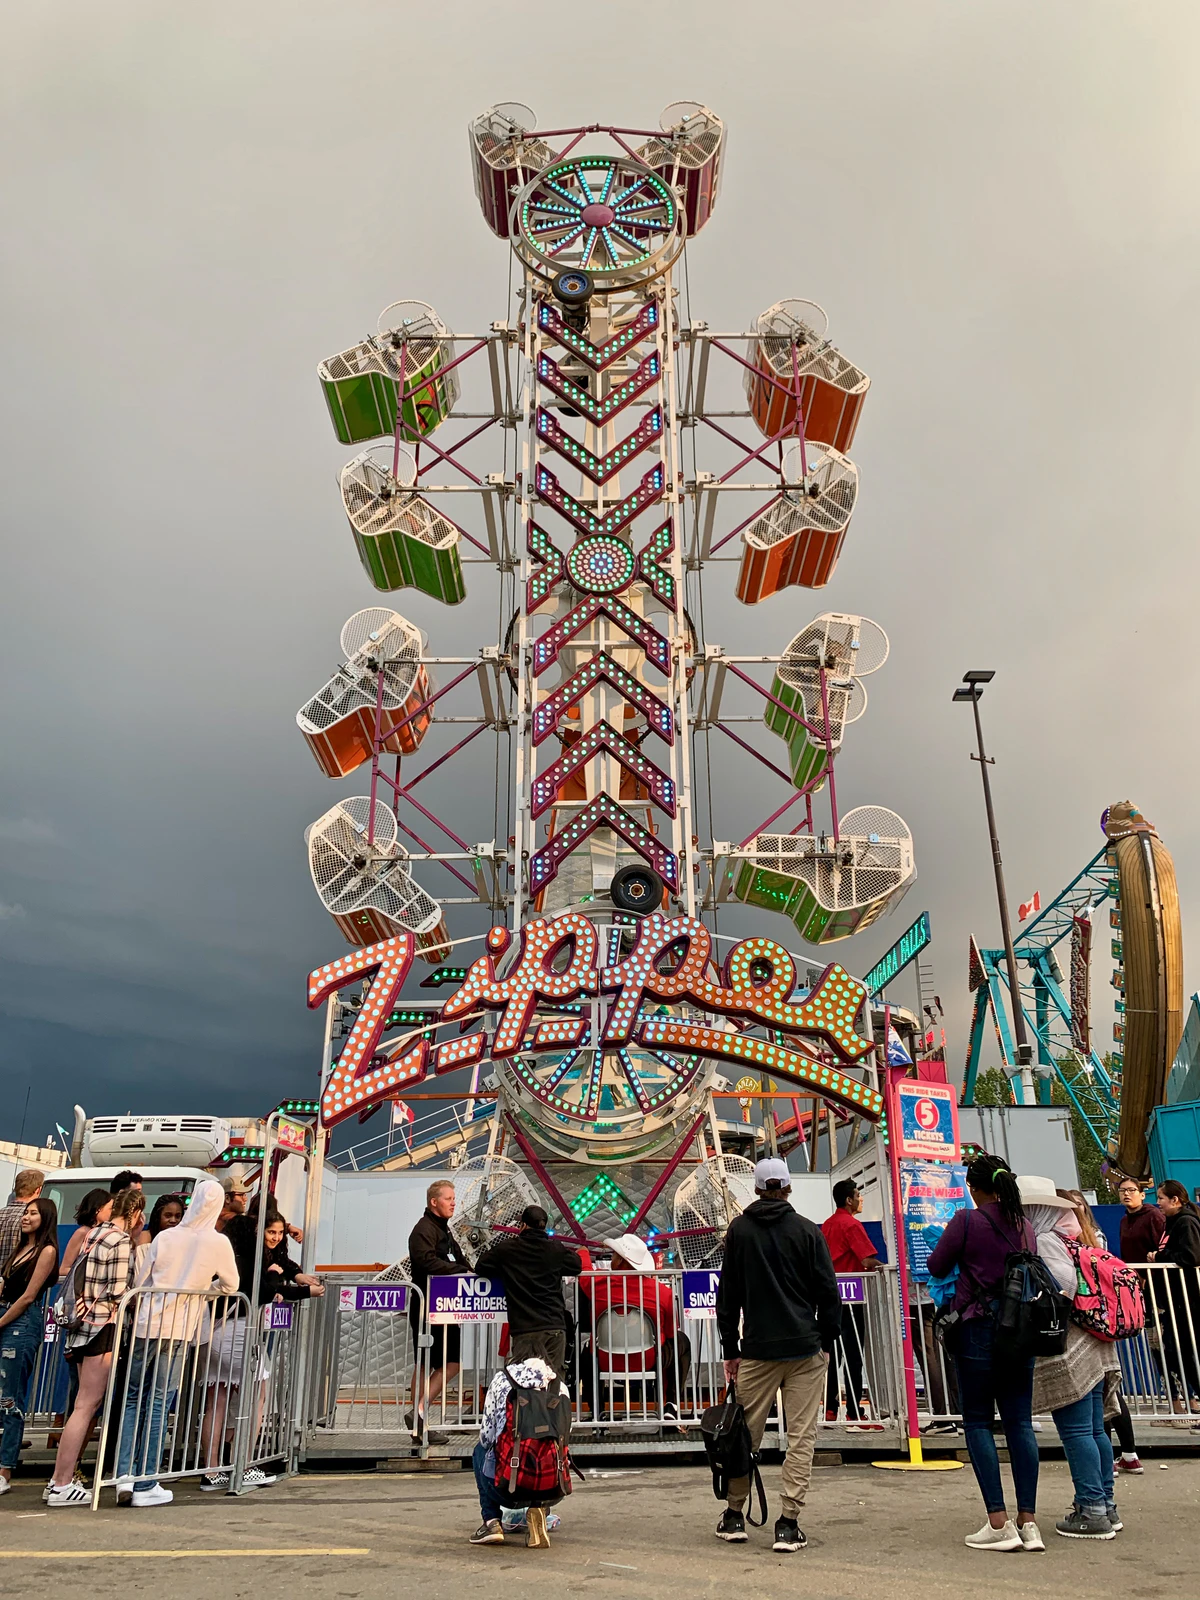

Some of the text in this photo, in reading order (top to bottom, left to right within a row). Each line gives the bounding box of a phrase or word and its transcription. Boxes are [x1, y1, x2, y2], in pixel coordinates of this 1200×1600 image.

[900, 917, 926, 965] FALLS
[307, 912, 880, 1128] Zipper
[735, 1078, 756, 1092] ANZAI
[920, 1102, 934, 1126] 5
[914, 1130, 944, 1142] TICKETS
[909, 1186, 964, 1198] SIZE WIZE
[458, 1278, 491, 1296] NO
[709, 1273, 720, 1292] N
[837, 1282, 857, 1298] IT
[362, 1290, 400, 1308] EXIT
[436, 1296, 508, 1311] SINGLE RIDERS
[690, 1292, 716, 1306] SING
[273, 1308, 289, 1326] EXIT
